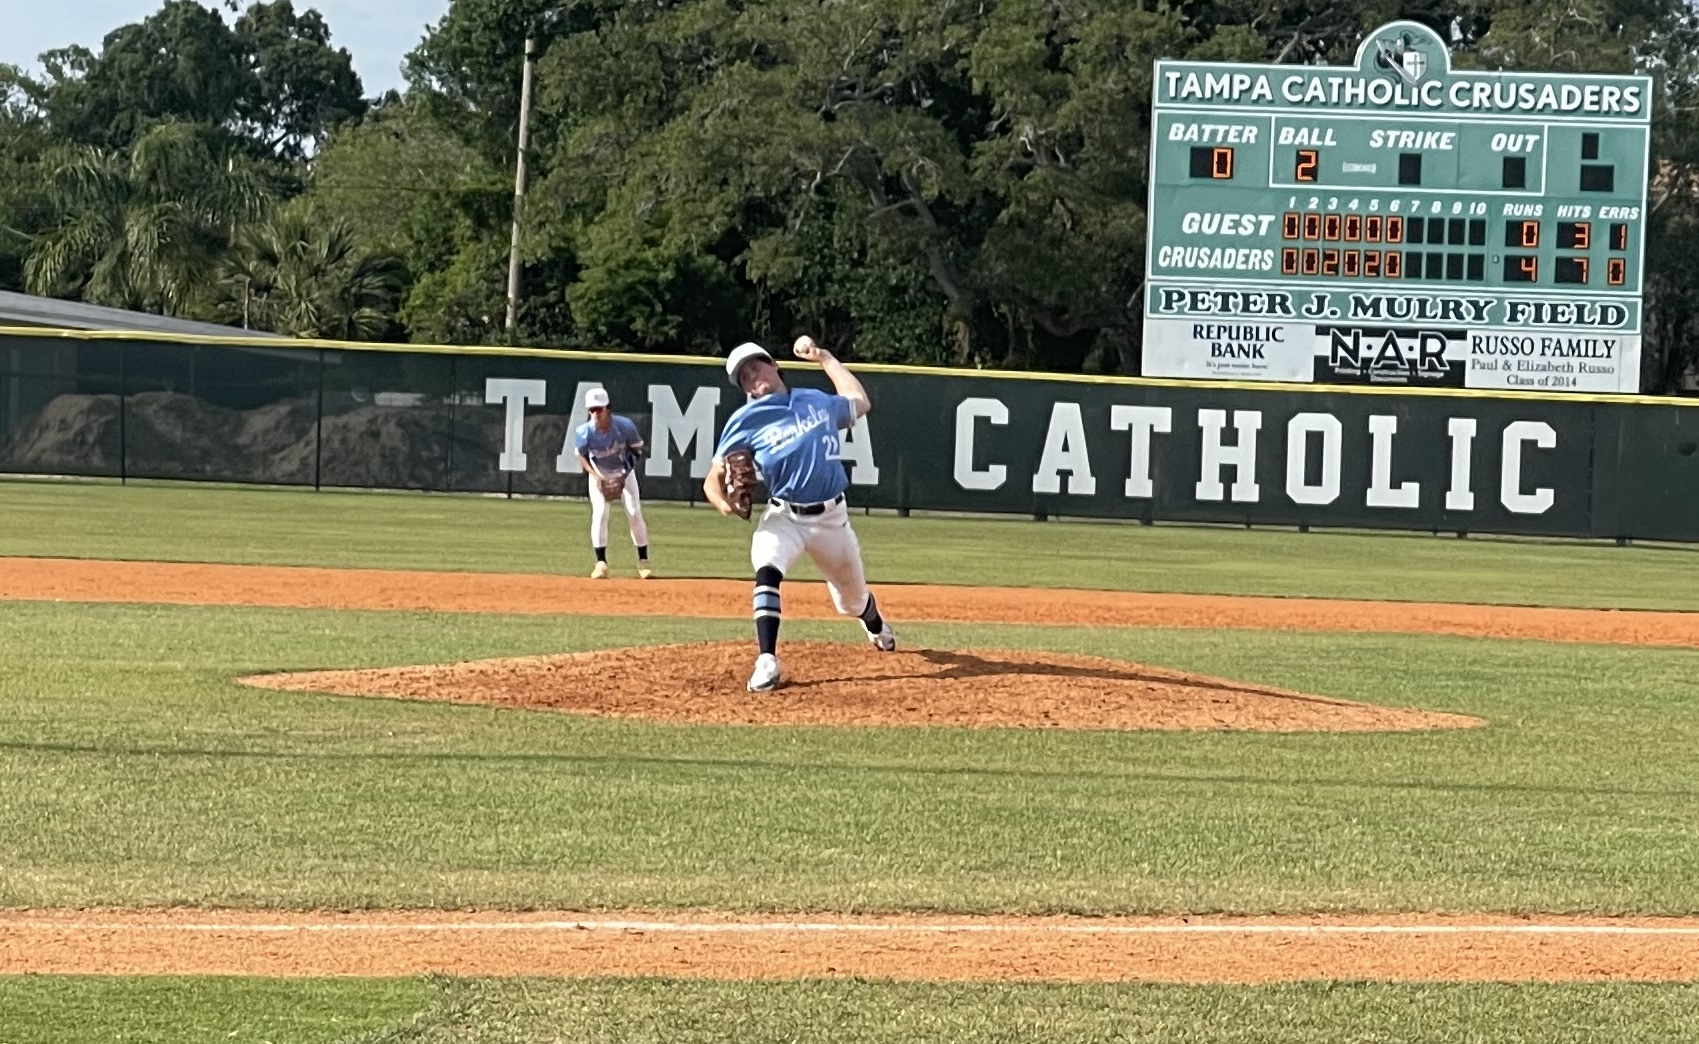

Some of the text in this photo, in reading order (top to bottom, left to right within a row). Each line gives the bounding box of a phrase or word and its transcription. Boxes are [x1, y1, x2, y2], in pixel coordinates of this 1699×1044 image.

[1166, 72, 1640, 113] TAMPA CATHOLIC CRUSADERS
[1168, 123, 1258, 144] BATTER
[1279, 127, 1337, 146] BALL
[1370, 130, 1455, 149] STRIKE
[1491, 133, 1539, 152] OUT
[1213, 148, 1232, 178] 0
[1297, 151, 1316, 181] 2
[1289, 196, 1486, 215] 1 2 3 4 5 6 7 8 9 10
[1503, 203, 1543, 216] RUNS
[1557, 205, 1591, 218] HITS
[1599, 206, 1639, 219] ERRS
[1182, 212, 1275, 236] GUEST
[1285, 213, 1402, 243] 0 0 0 0 0 0
[1523, 221, 1538, 247] 0
[1574, 223, 1588, 248] 3
[1621, 224, 1626, 249] 1
[1158, 246, 1274, 271] CRUSADERS
[1283, 249, 1400, 277] 0 0 2 0 2 0
[1521, 256, 1536, 282] 4
[1573, 258, 1587, 284] 7
[1609, 259, 1625, 284] 0
[1160, 288, 1628, 328] PETER J. MULRY FIELD
[1192, 324, 1285, 342] REPUBLIC
[1211, 342, 1265, 359] BANK
[1471, 335, 1616, 358] RUSSO FAMILY
[1471, 358, 1615, 374] Paul & Elizabeth Russo
[1506, 374, 1577, 387] Class of 2014
[954, 397, 1557, 514] CATHOLIC
